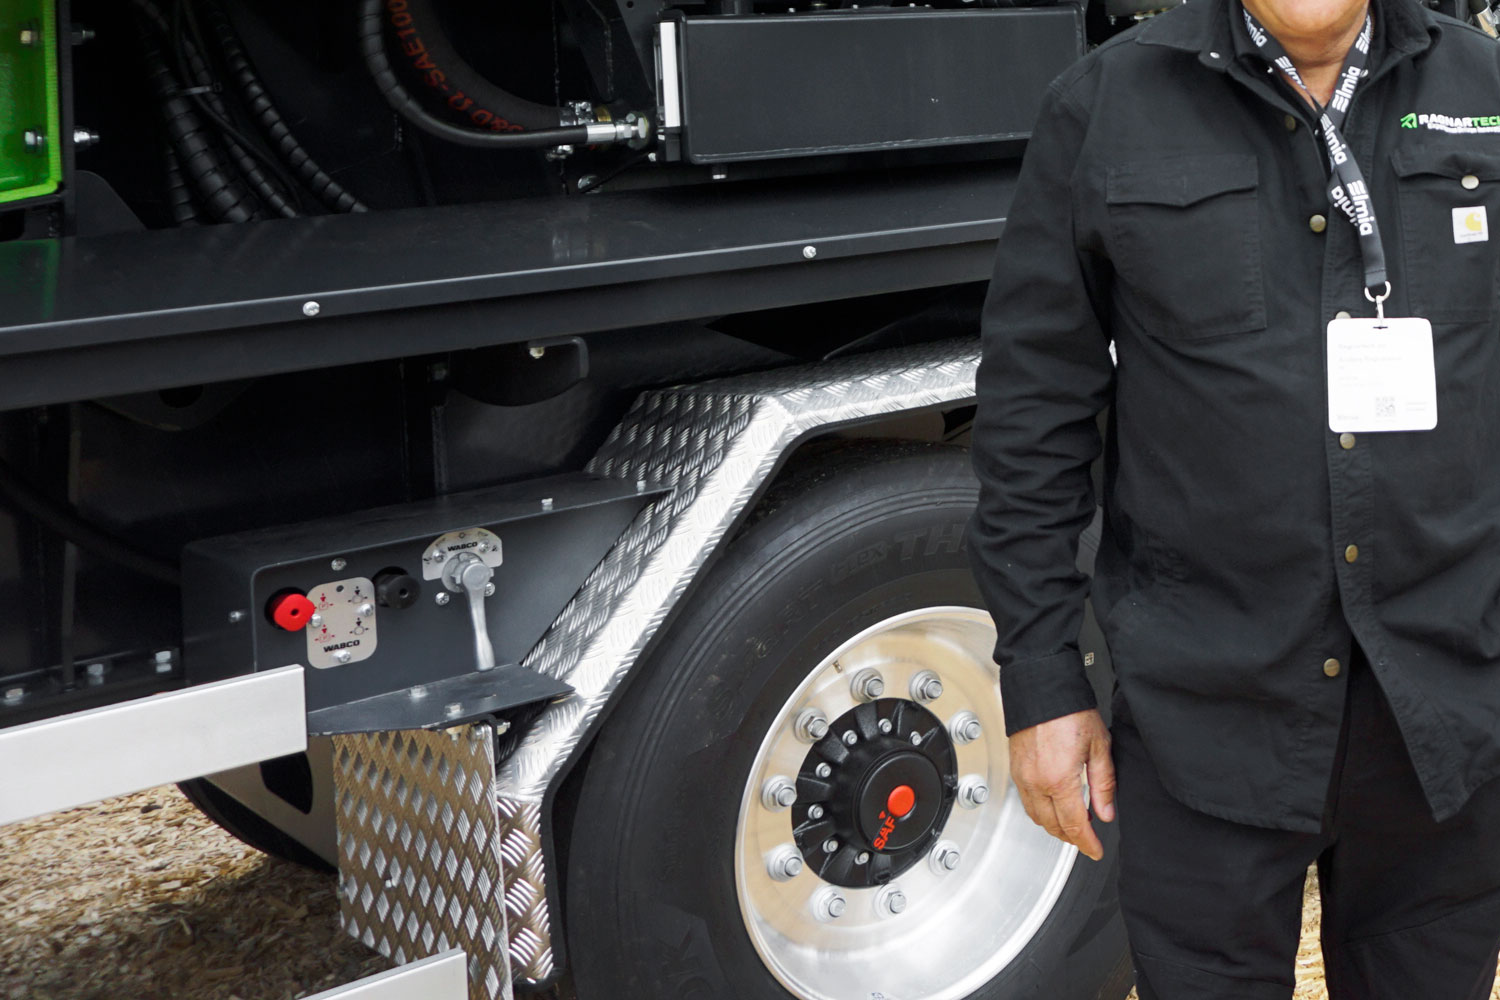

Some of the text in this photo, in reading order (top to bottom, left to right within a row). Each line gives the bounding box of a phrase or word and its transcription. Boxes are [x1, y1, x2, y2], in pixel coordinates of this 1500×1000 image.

[1332, 66, 1361, 112] Elmia
[1320, 113, 1348, 165] Elmia
[1347, 180, 1375, 236] Elmia
[447, 541, 478, 552] WABCO
[323, 639, 361, 653] WABCO
[873, 816, 896, 850] SAF
